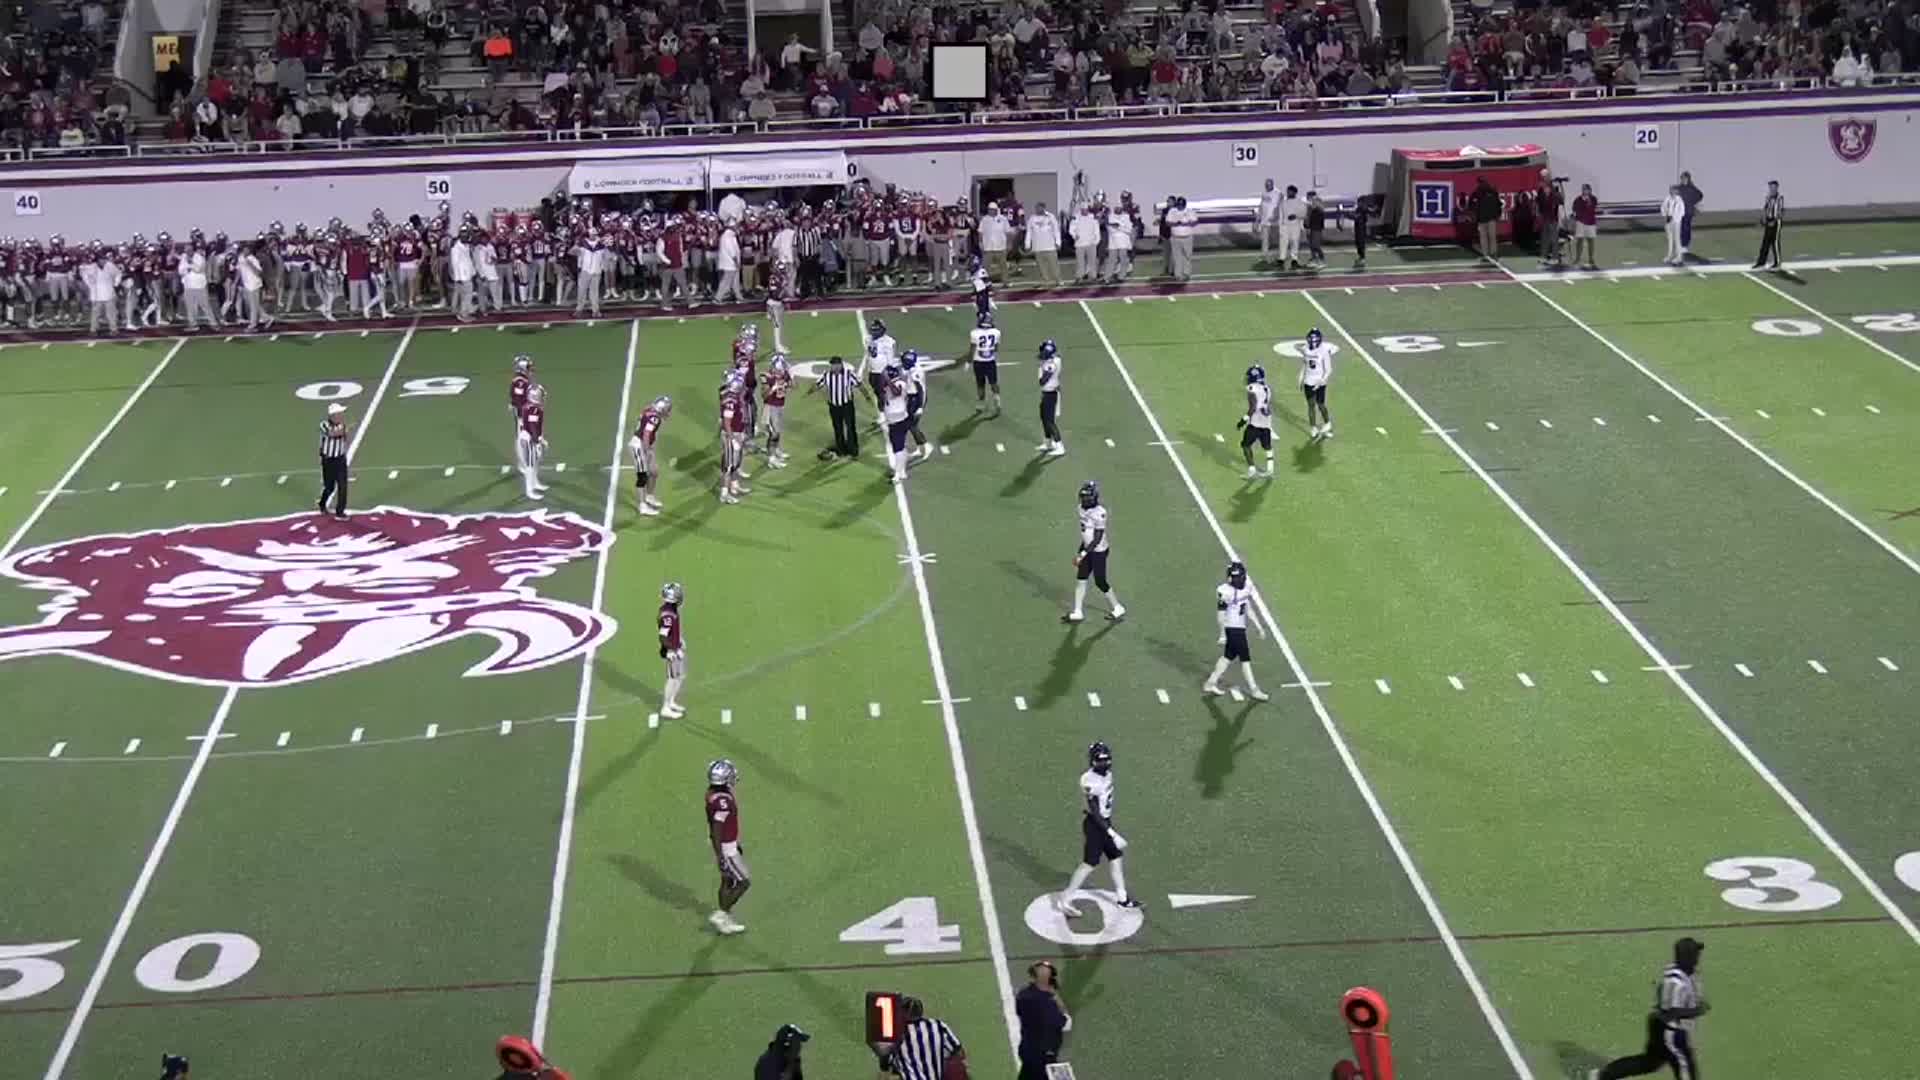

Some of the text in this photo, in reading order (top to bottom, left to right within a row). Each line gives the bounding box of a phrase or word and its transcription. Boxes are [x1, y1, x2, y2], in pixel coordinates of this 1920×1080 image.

[1636, 130, 1658, 145] 20
[1234, 147, 1257, 161] 30
[428, 181, 449, 194] 50
[17, 195, 38, 209] 40
[978, 334, 995, 348] 27
[720, 799, 728, 810] 5
[876, 997, 893, 1038] 1
